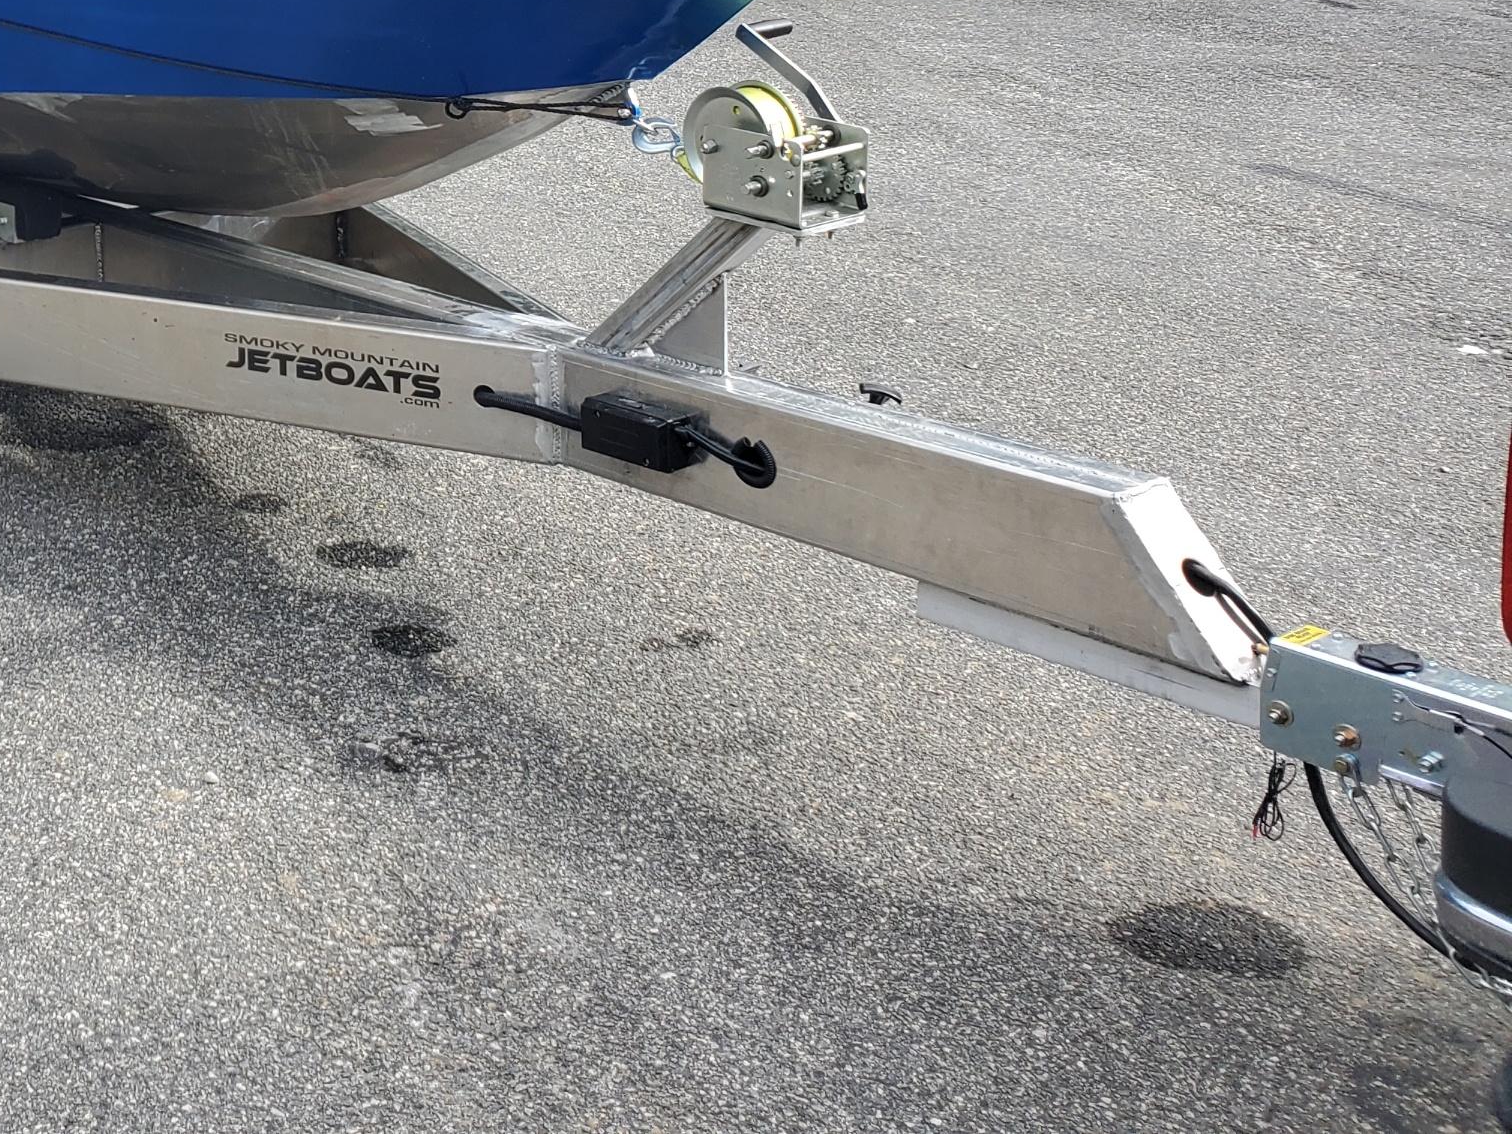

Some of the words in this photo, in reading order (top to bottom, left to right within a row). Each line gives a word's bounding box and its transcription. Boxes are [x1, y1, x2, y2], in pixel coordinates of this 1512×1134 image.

[224, 332, 305, 353] SMOKY
[311, 345, 440, 374] MOUNTAIN
[226, 346, 442, 400] JETBOATS
[399, 397, 441, 409] .com
